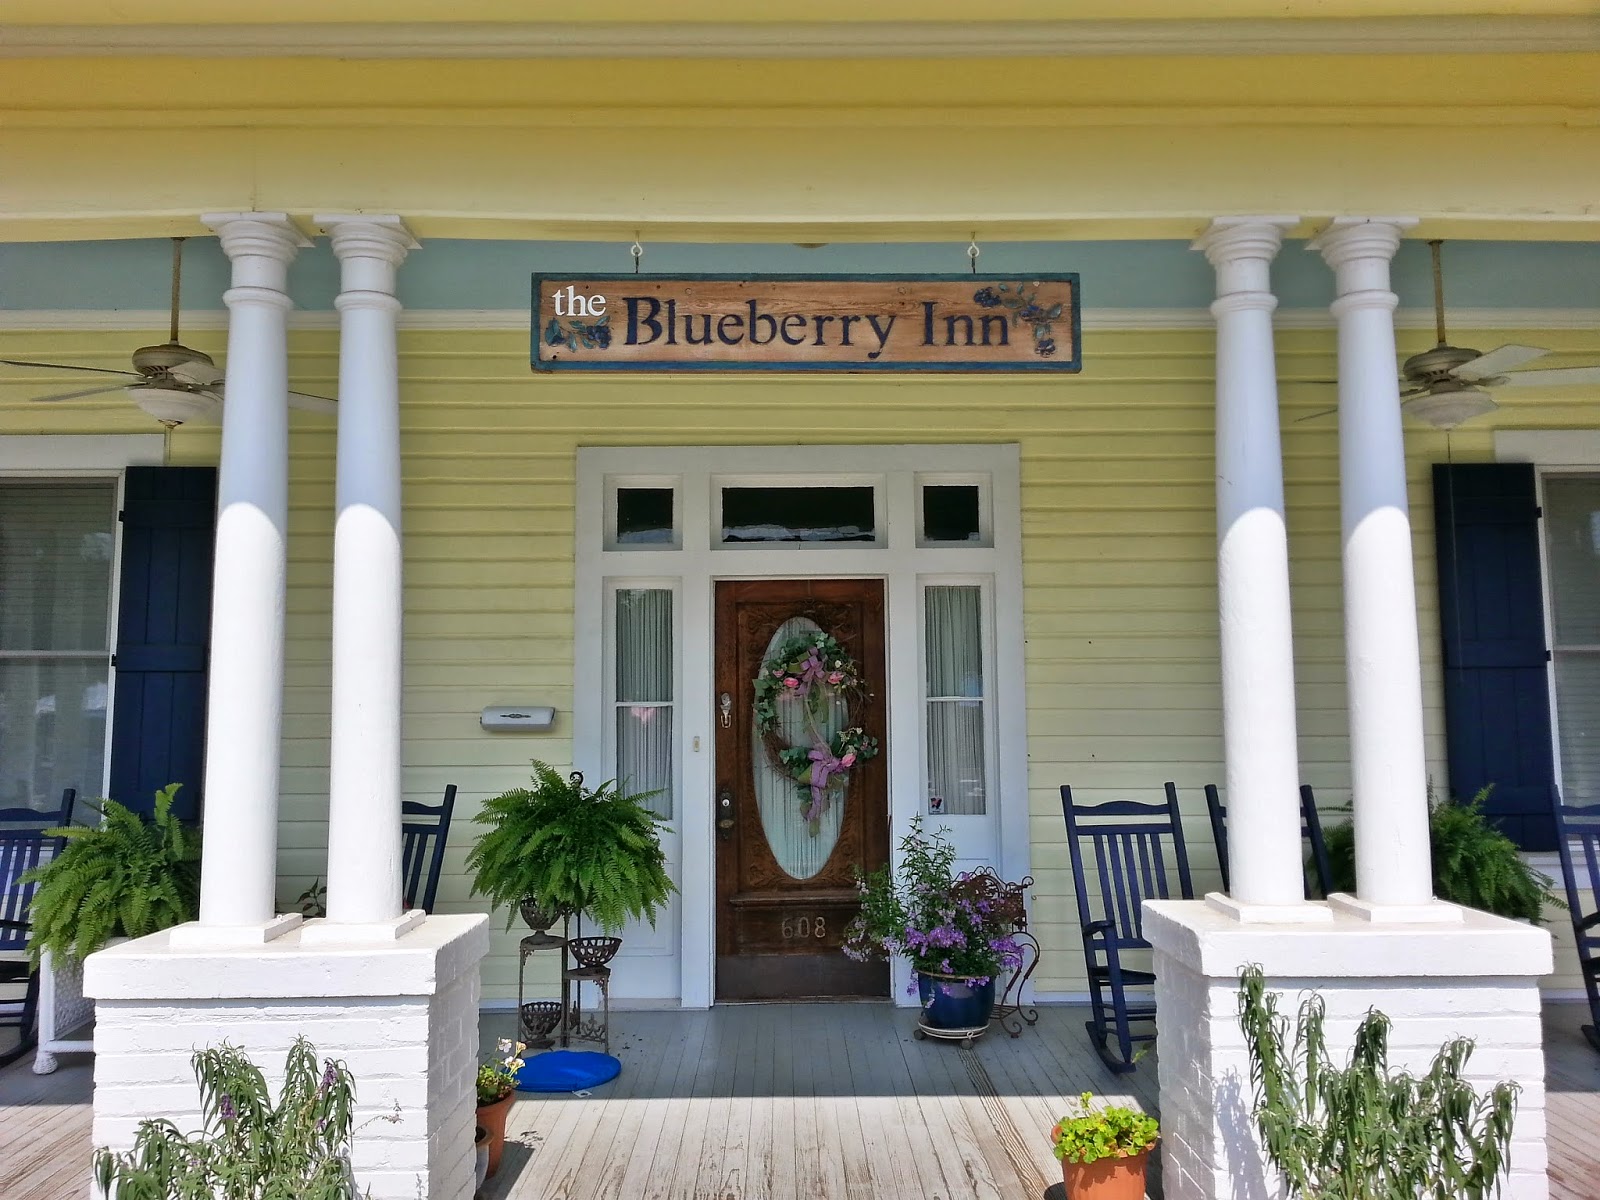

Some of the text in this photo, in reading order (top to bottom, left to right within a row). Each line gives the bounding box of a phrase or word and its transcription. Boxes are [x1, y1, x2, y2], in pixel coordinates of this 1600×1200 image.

[551, 285, 1010, 359] the Blueberry Inn
[781, 916, 826, 939] 608
